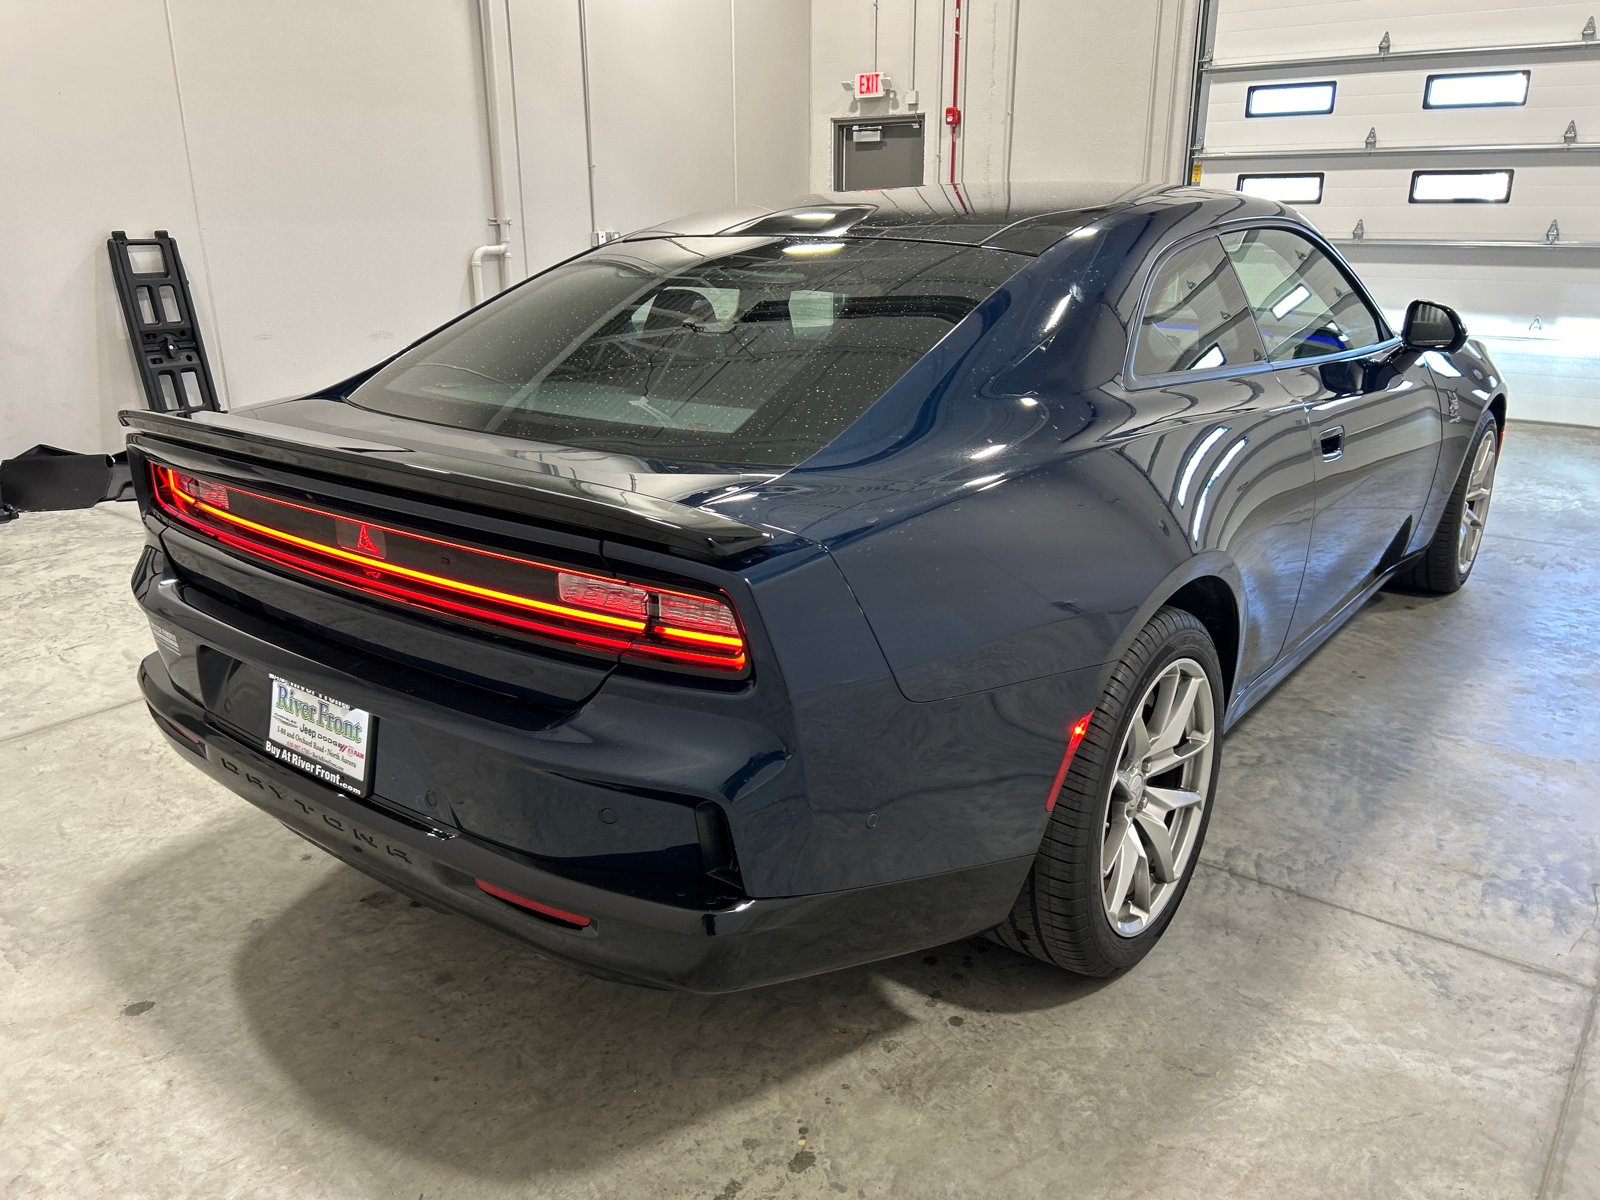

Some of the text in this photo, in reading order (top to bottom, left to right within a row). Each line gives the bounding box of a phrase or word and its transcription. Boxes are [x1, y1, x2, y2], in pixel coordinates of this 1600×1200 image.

[859, 73, 880, 94] EXIT
[299, 723, 317, 739] Jeep
[286, 731, 295, 740] and
[295, 733, 312, 748] Orchard
[313, 741, 325, 753] Road
[326, 748, 340, 761] North
[340, 755, 357, 769] Aurora
[317, 733, 343, 749] DODGE
[353, 750, 365, 760] RAM
[265, 740, 361, 795] Buy At River Front.com
